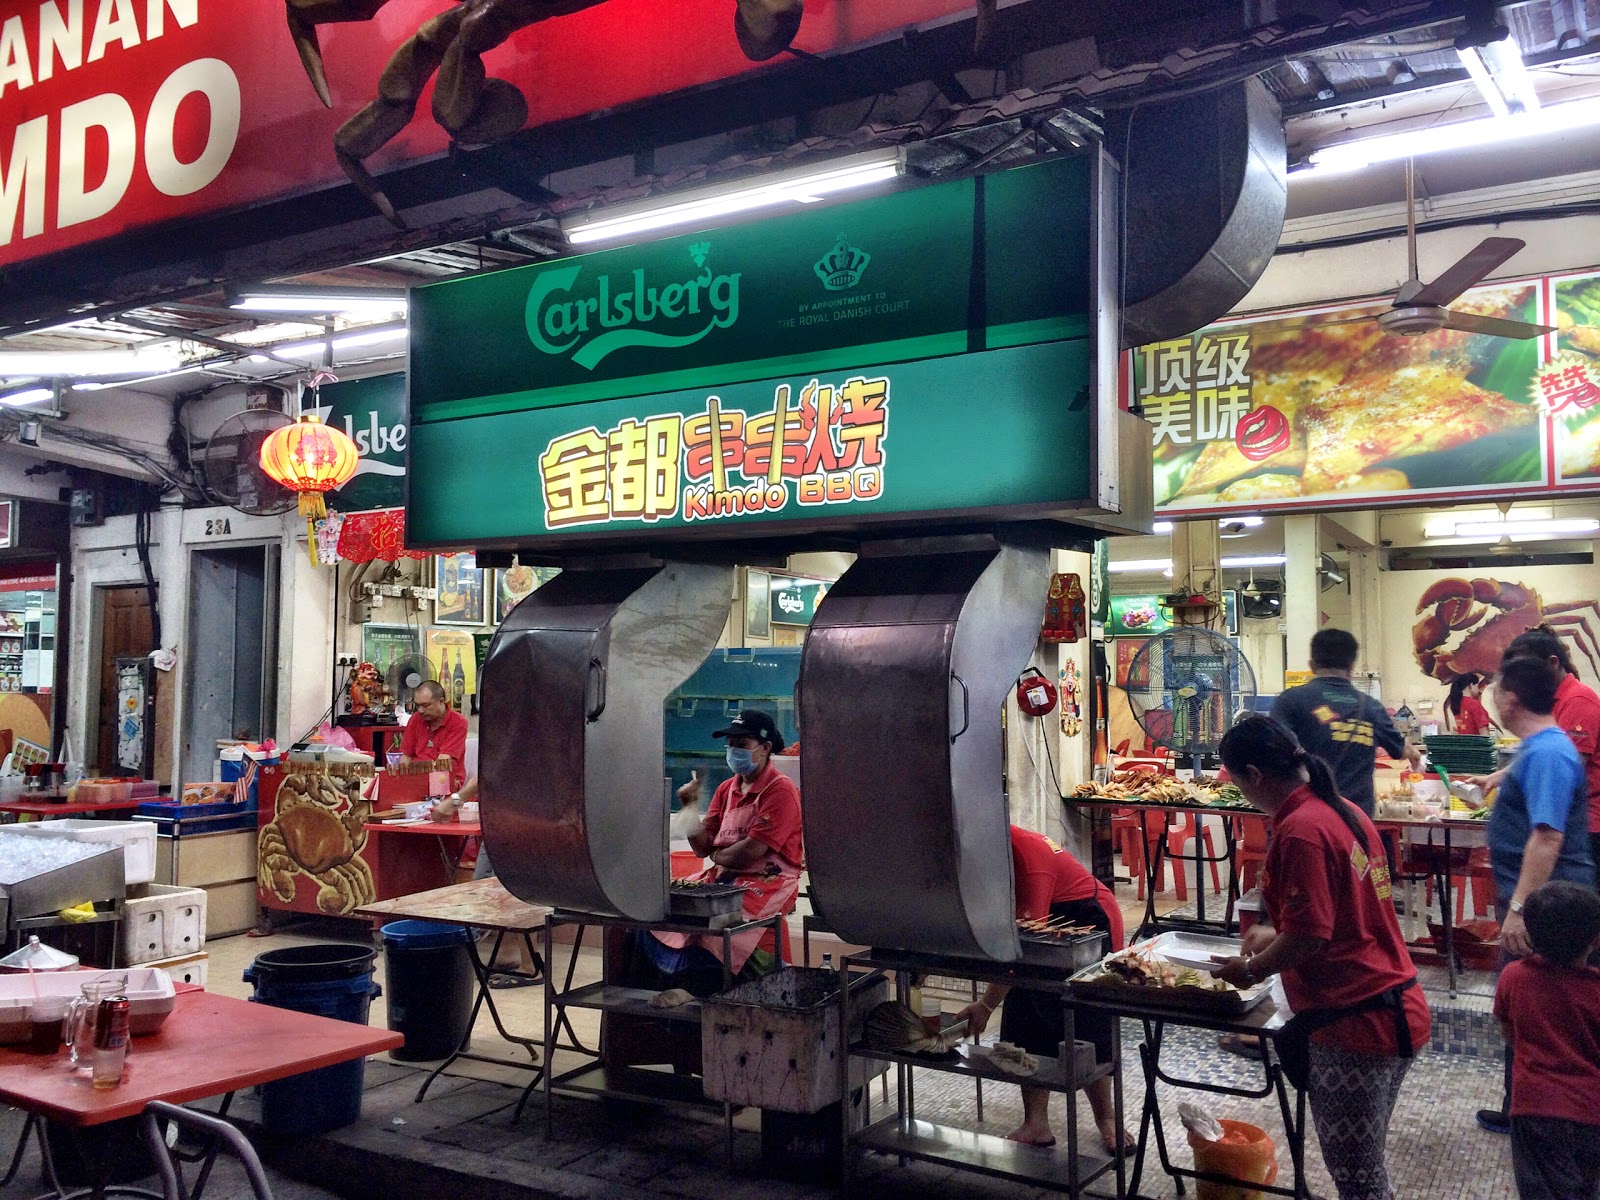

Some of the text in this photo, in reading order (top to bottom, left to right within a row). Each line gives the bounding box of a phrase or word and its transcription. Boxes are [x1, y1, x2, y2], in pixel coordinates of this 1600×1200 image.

[525, 264, 742, 355] Carlsberg
[777, 300, 911, 329] THE ROYAL DANISH COURT
[812, 294, 872, 310] APPOINTMENT
[875, 292, 886, 300] TO
[1140, 334, 1251, 396] 顶级
[1141, 385, 1251, 446] 美味
[541, 378, 888, 527] 金都串串烧
[685, 467, 882, 520] Kimdo BBQ
[205, 518, 232, 535] 23A
